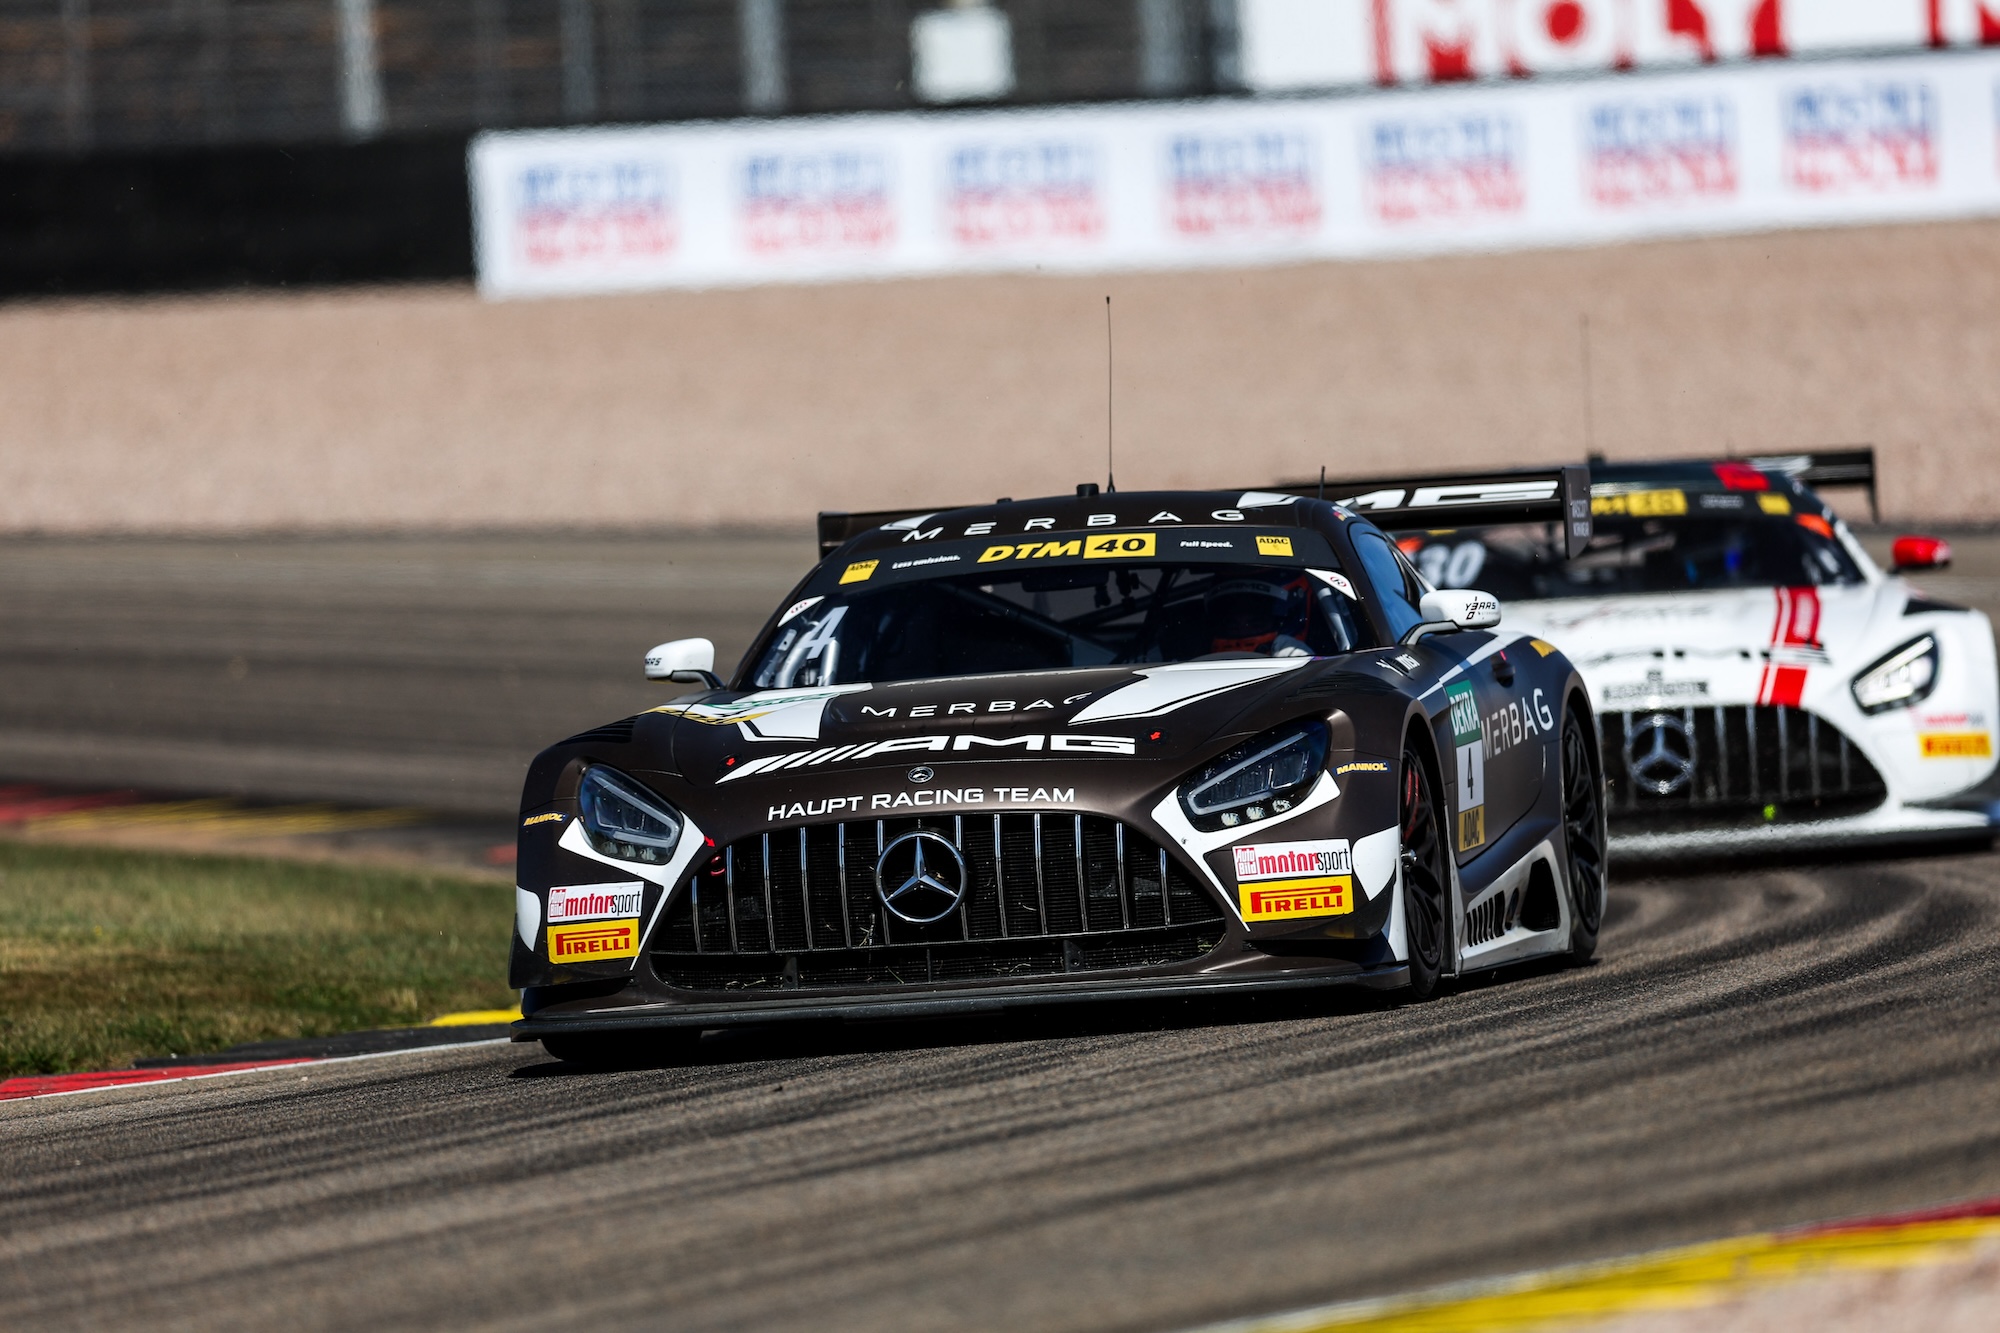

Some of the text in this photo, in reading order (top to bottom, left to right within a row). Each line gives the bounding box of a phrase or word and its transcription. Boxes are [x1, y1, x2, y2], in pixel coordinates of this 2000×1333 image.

[902, 509, 1245, 542] MERBAG
[977, 537, 1147, 563] DTM 40
[848, 562, 876, 572] ADAC
[805, 606, 849, 660] 4
[1450, 689, 1481, 737] DEKRA
[1480, 687, 1555, 762] MERBAG
[1337, 763, 1388, 774] MANNOL
[1467, 748, 1474, 800] 4
[767, 786, 1076, 821] HAUPT RACING TEAM
[524, 813, 563, 826] MANNOL
[1463, 812, 1480, 849] ADAC
[1259, 848, 1350, 874] motorsport
[565, 891, 641, 916] motorsport
[1250, 885, 1343, 914] PIRELLI
[556, 928, 630, 955] PIRELLI
